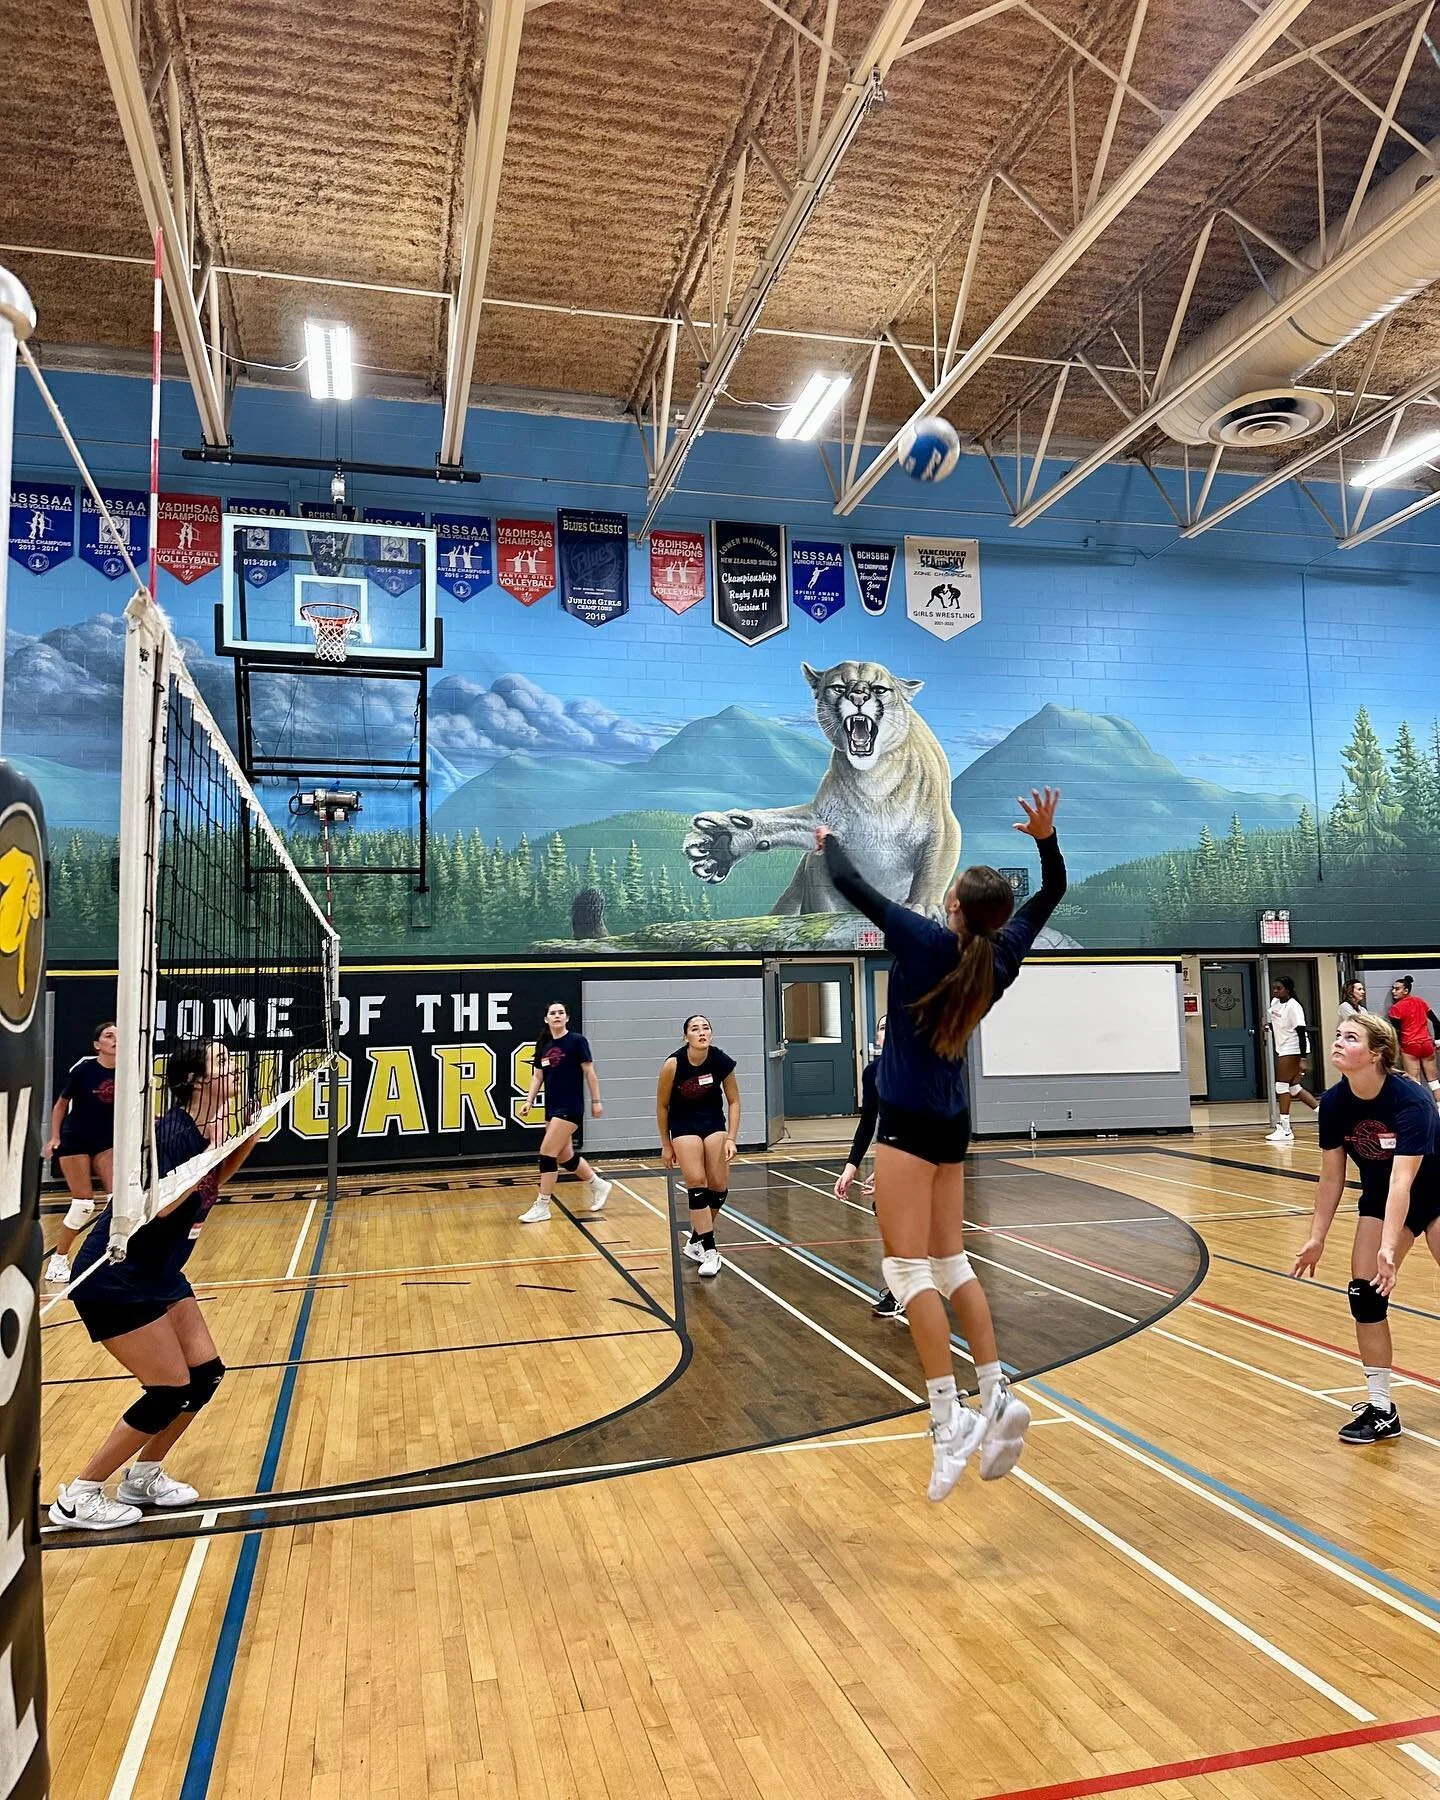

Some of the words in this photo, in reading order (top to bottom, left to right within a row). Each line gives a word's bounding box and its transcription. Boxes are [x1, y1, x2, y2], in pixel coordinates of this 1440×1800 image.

[10, 493, 72, 506] NSSSAA
[29, 503, 72, 511] VOLLEYBALL
[158, 502, 218, 514] V&DIHSAA
[158, 512, 219, 522] CHAMPIONS
[433, 524, 488, 536] NSSSAA
[498, 528, 552, 539] V&DIHSAA
[498, 537, 552, 547] CHAMPIONS
[652, 539, 703, 550] V&DIHSAA
[719, 538, 741, 555] LOWER
[743, 537, 777, 557] MAINLAND
[652, 547, 703, 557] CHAMPIONS
[793, 551, 841, 561] NSSSAA
[857, 551, 889, 560] BCHSBBA
[918, 549, 966, 557] VANCOUVER
[157, 555, 219, 565] VOLLEYBALL
[920, 555, 935, 567] SEA
[499, 578, 554, 587] VOLLEYBALL
[722, 572, 776, 584] Championships
[652, 587, 704, 597] VOLLEYBALL
[729, 590, 750, 600] Rugby
[752, 589, 769, 598] AAA
[732, 603, 760, 612] Division
[416, 993, 513, 1033] THE
[69, 1041, 546, 1142] UGARS
